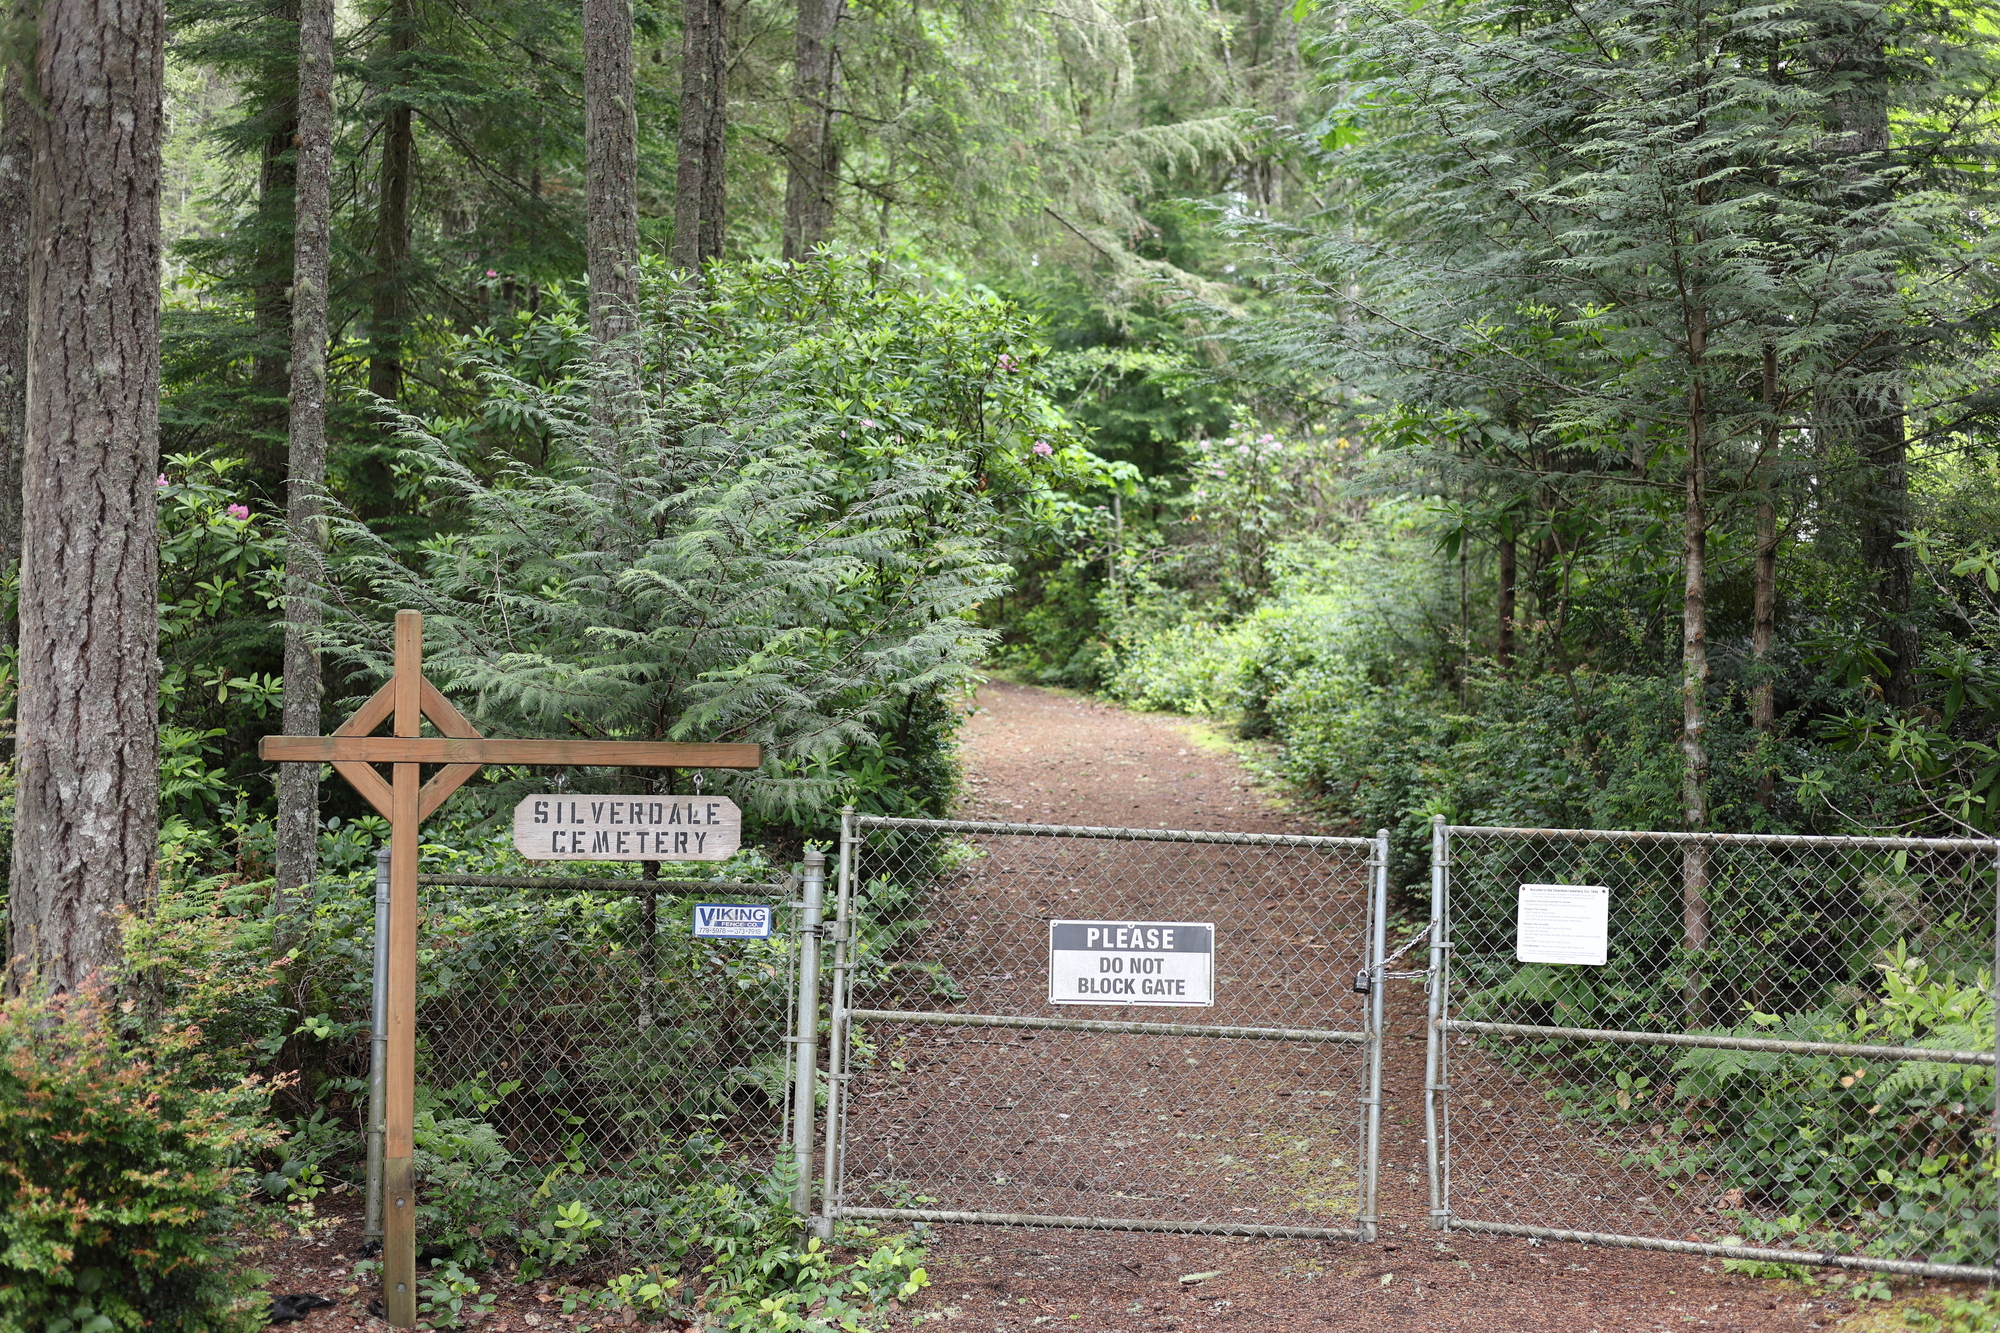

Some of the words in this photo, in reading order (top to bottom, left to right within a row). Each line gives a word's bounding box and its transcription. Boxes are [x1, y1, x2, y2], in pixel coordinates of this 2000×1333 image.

[534, 801, 721, 825] SILVERDALE
[552, 830, 707, 854] CEMETERY
[699, 908, 766, 926] VIKING
[1087, 927, 1174, 950] PLEASE
[1099, 957, 1123, 973] DO
[1129, 957, 1165, 974] NOT
[1077, 977, 1136, 995] BLOCK
[1141, 979, 1186, 996] GATE
